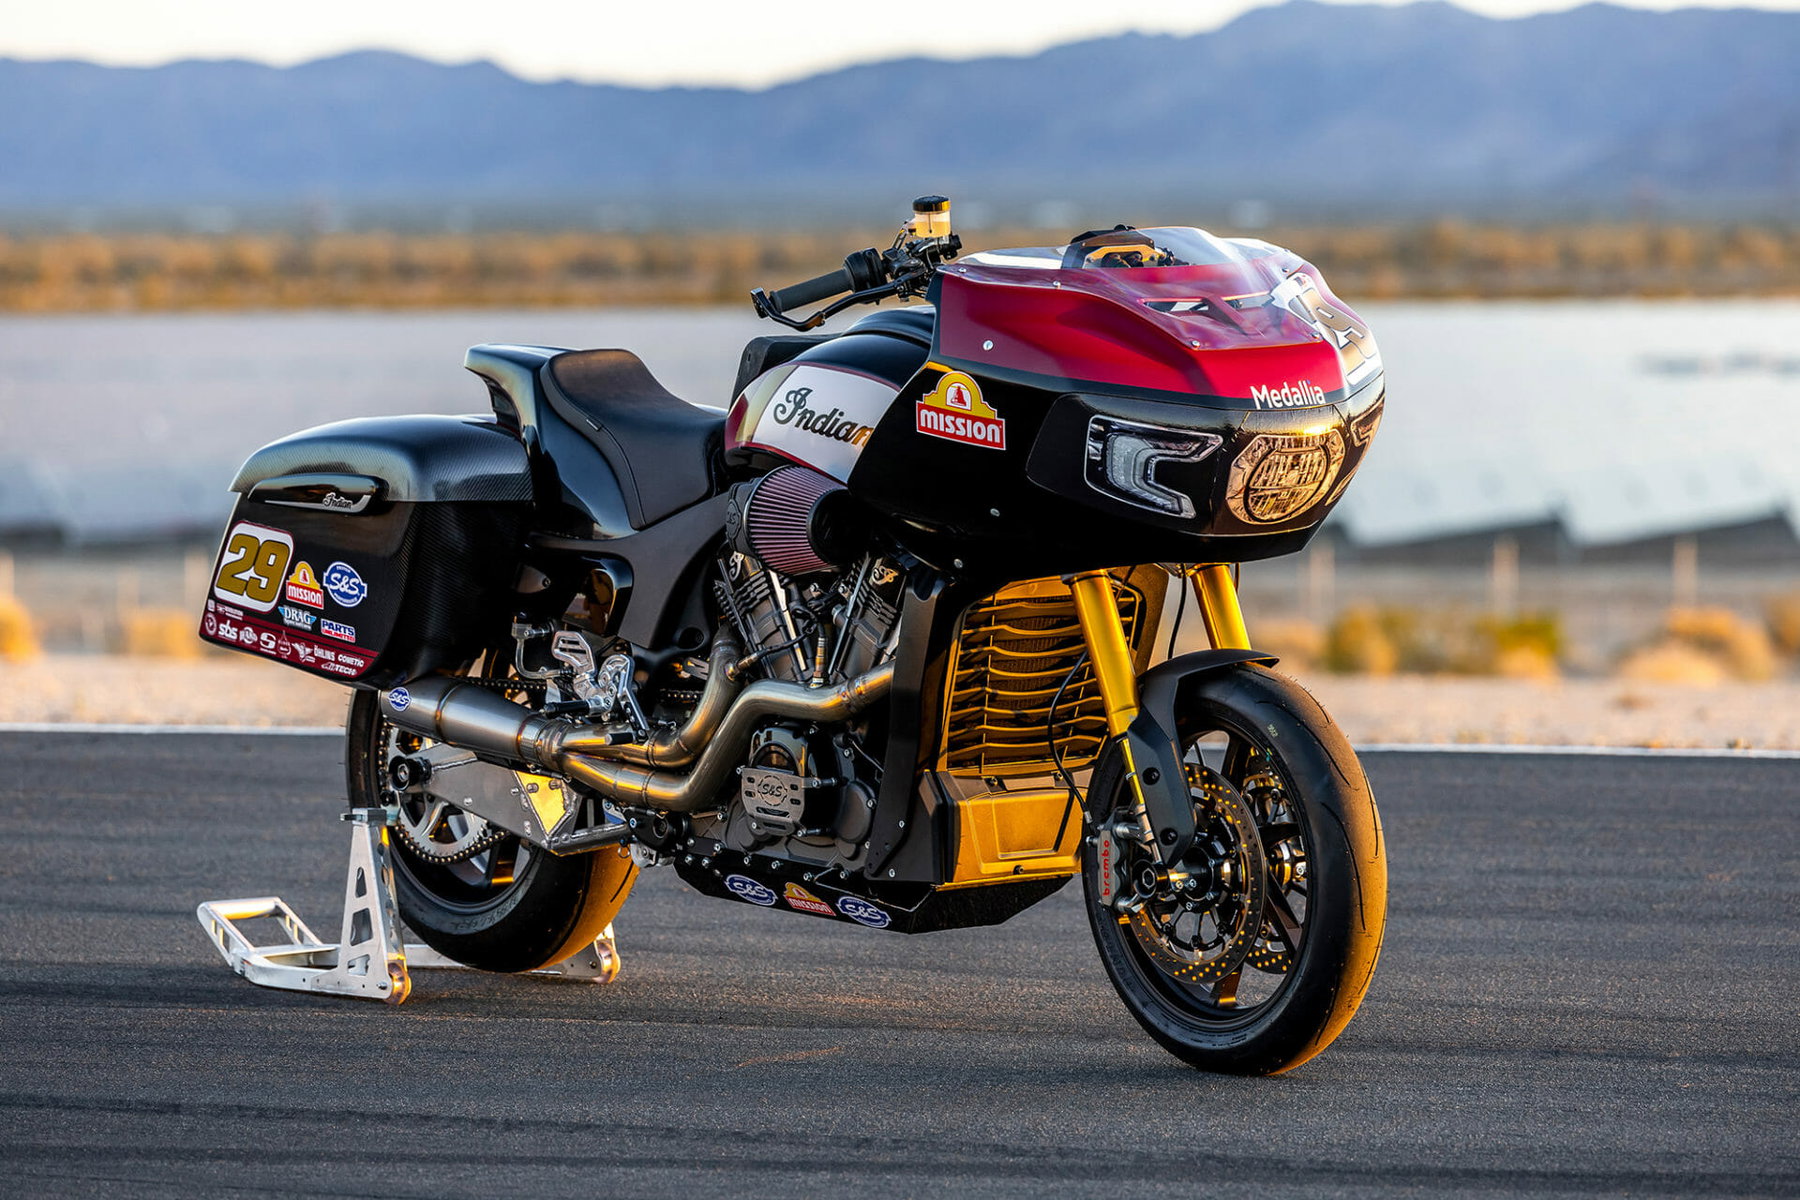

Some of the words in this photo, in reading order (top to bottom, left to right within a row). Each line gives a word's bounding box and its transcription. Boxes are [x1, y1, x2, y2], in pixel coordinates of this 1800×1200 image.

[1250, 379, 1326, 410] Medallia
[773, 387, 875, 447] Indian
[920, 409, 1000, 443] MISSION
[216, 533, 290, 603] 29
[329, 573, 359, 595] S&S
[288, 585, 322, 605] MISSION
[283, 606, 311, 624] DRAG
[219, 619, 238, 639] sbs
[322, 620, 354, 636] PARTS
[390, 692, 408, 704] S&S
[761, 783, 783, 796] S&S
[1101, 840, 1110, 896] brembo
[732, 882, 768, 897] S&S
[844, 904, 881, 919] S&S
